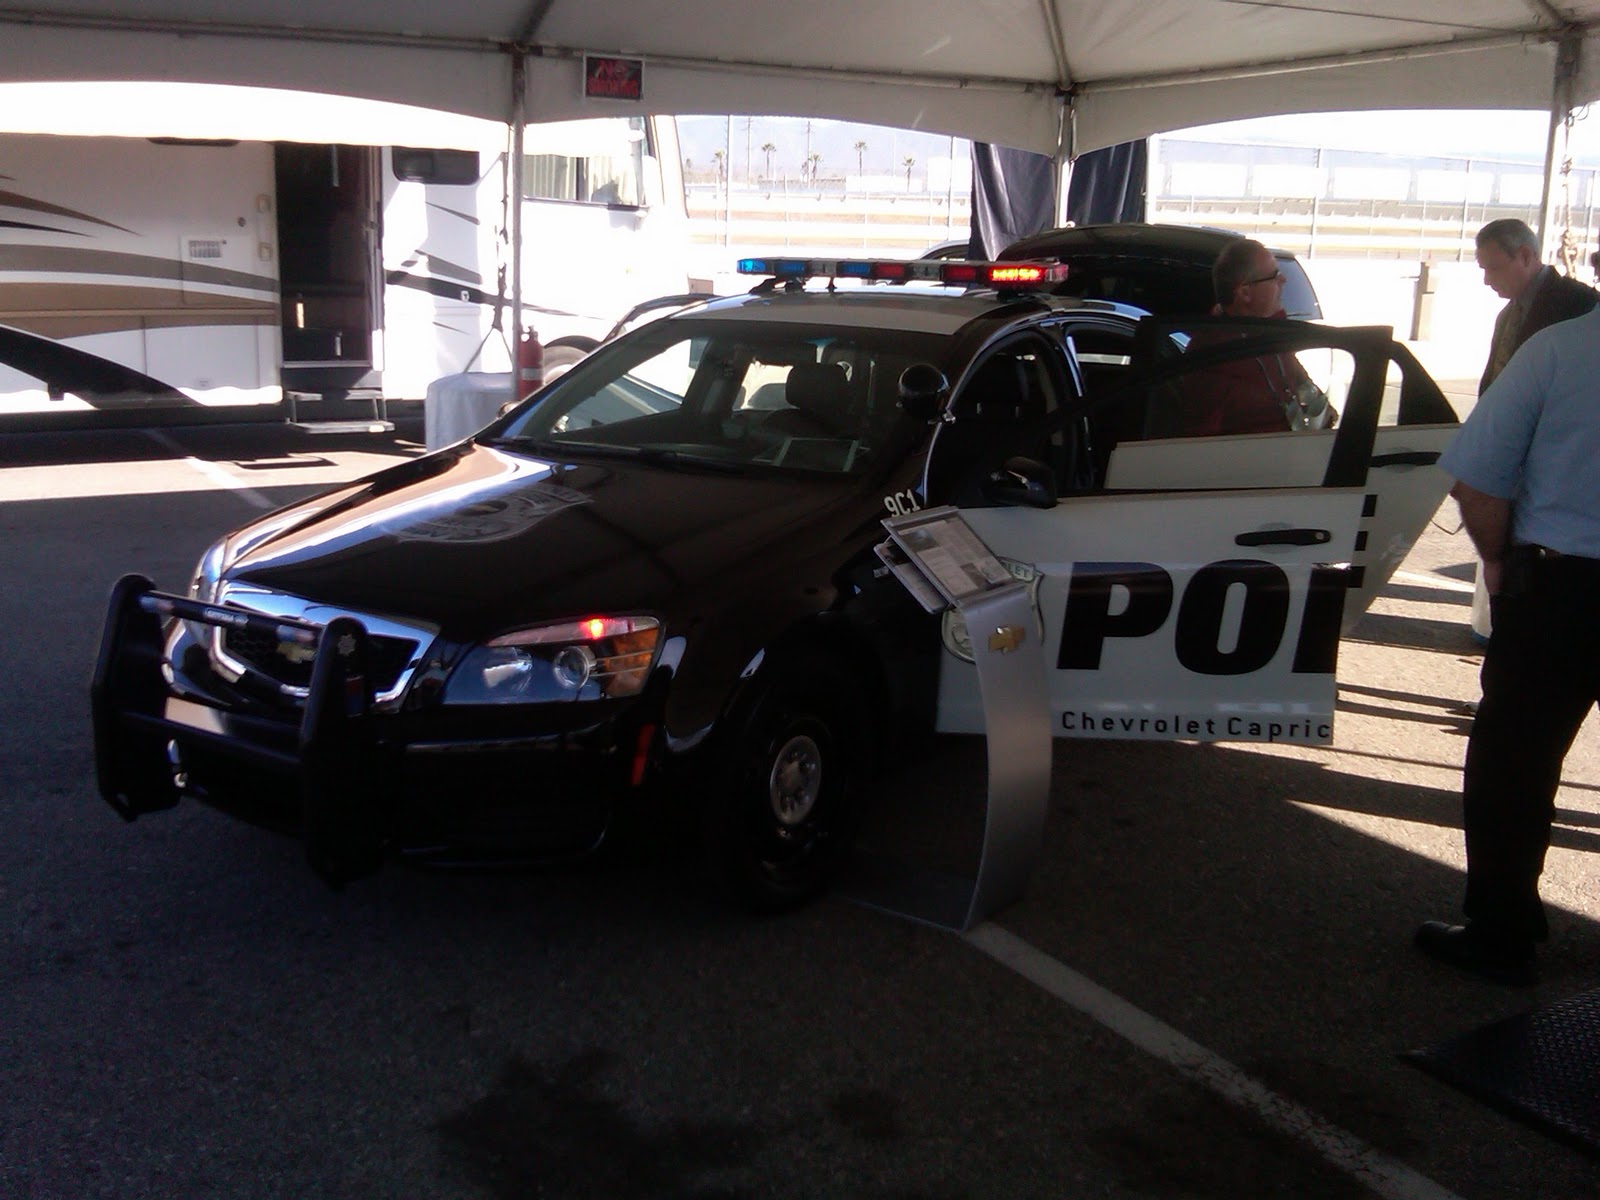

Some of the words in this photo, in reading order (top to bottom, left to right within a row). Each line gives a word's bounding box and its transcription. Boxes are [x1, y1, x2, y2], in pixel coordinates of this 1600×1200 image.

[884, 489, 921, 517] 9C1
[1062, 711, 1215, 735] Chevrolet
[1227, 717, 1331, 742] Capric
